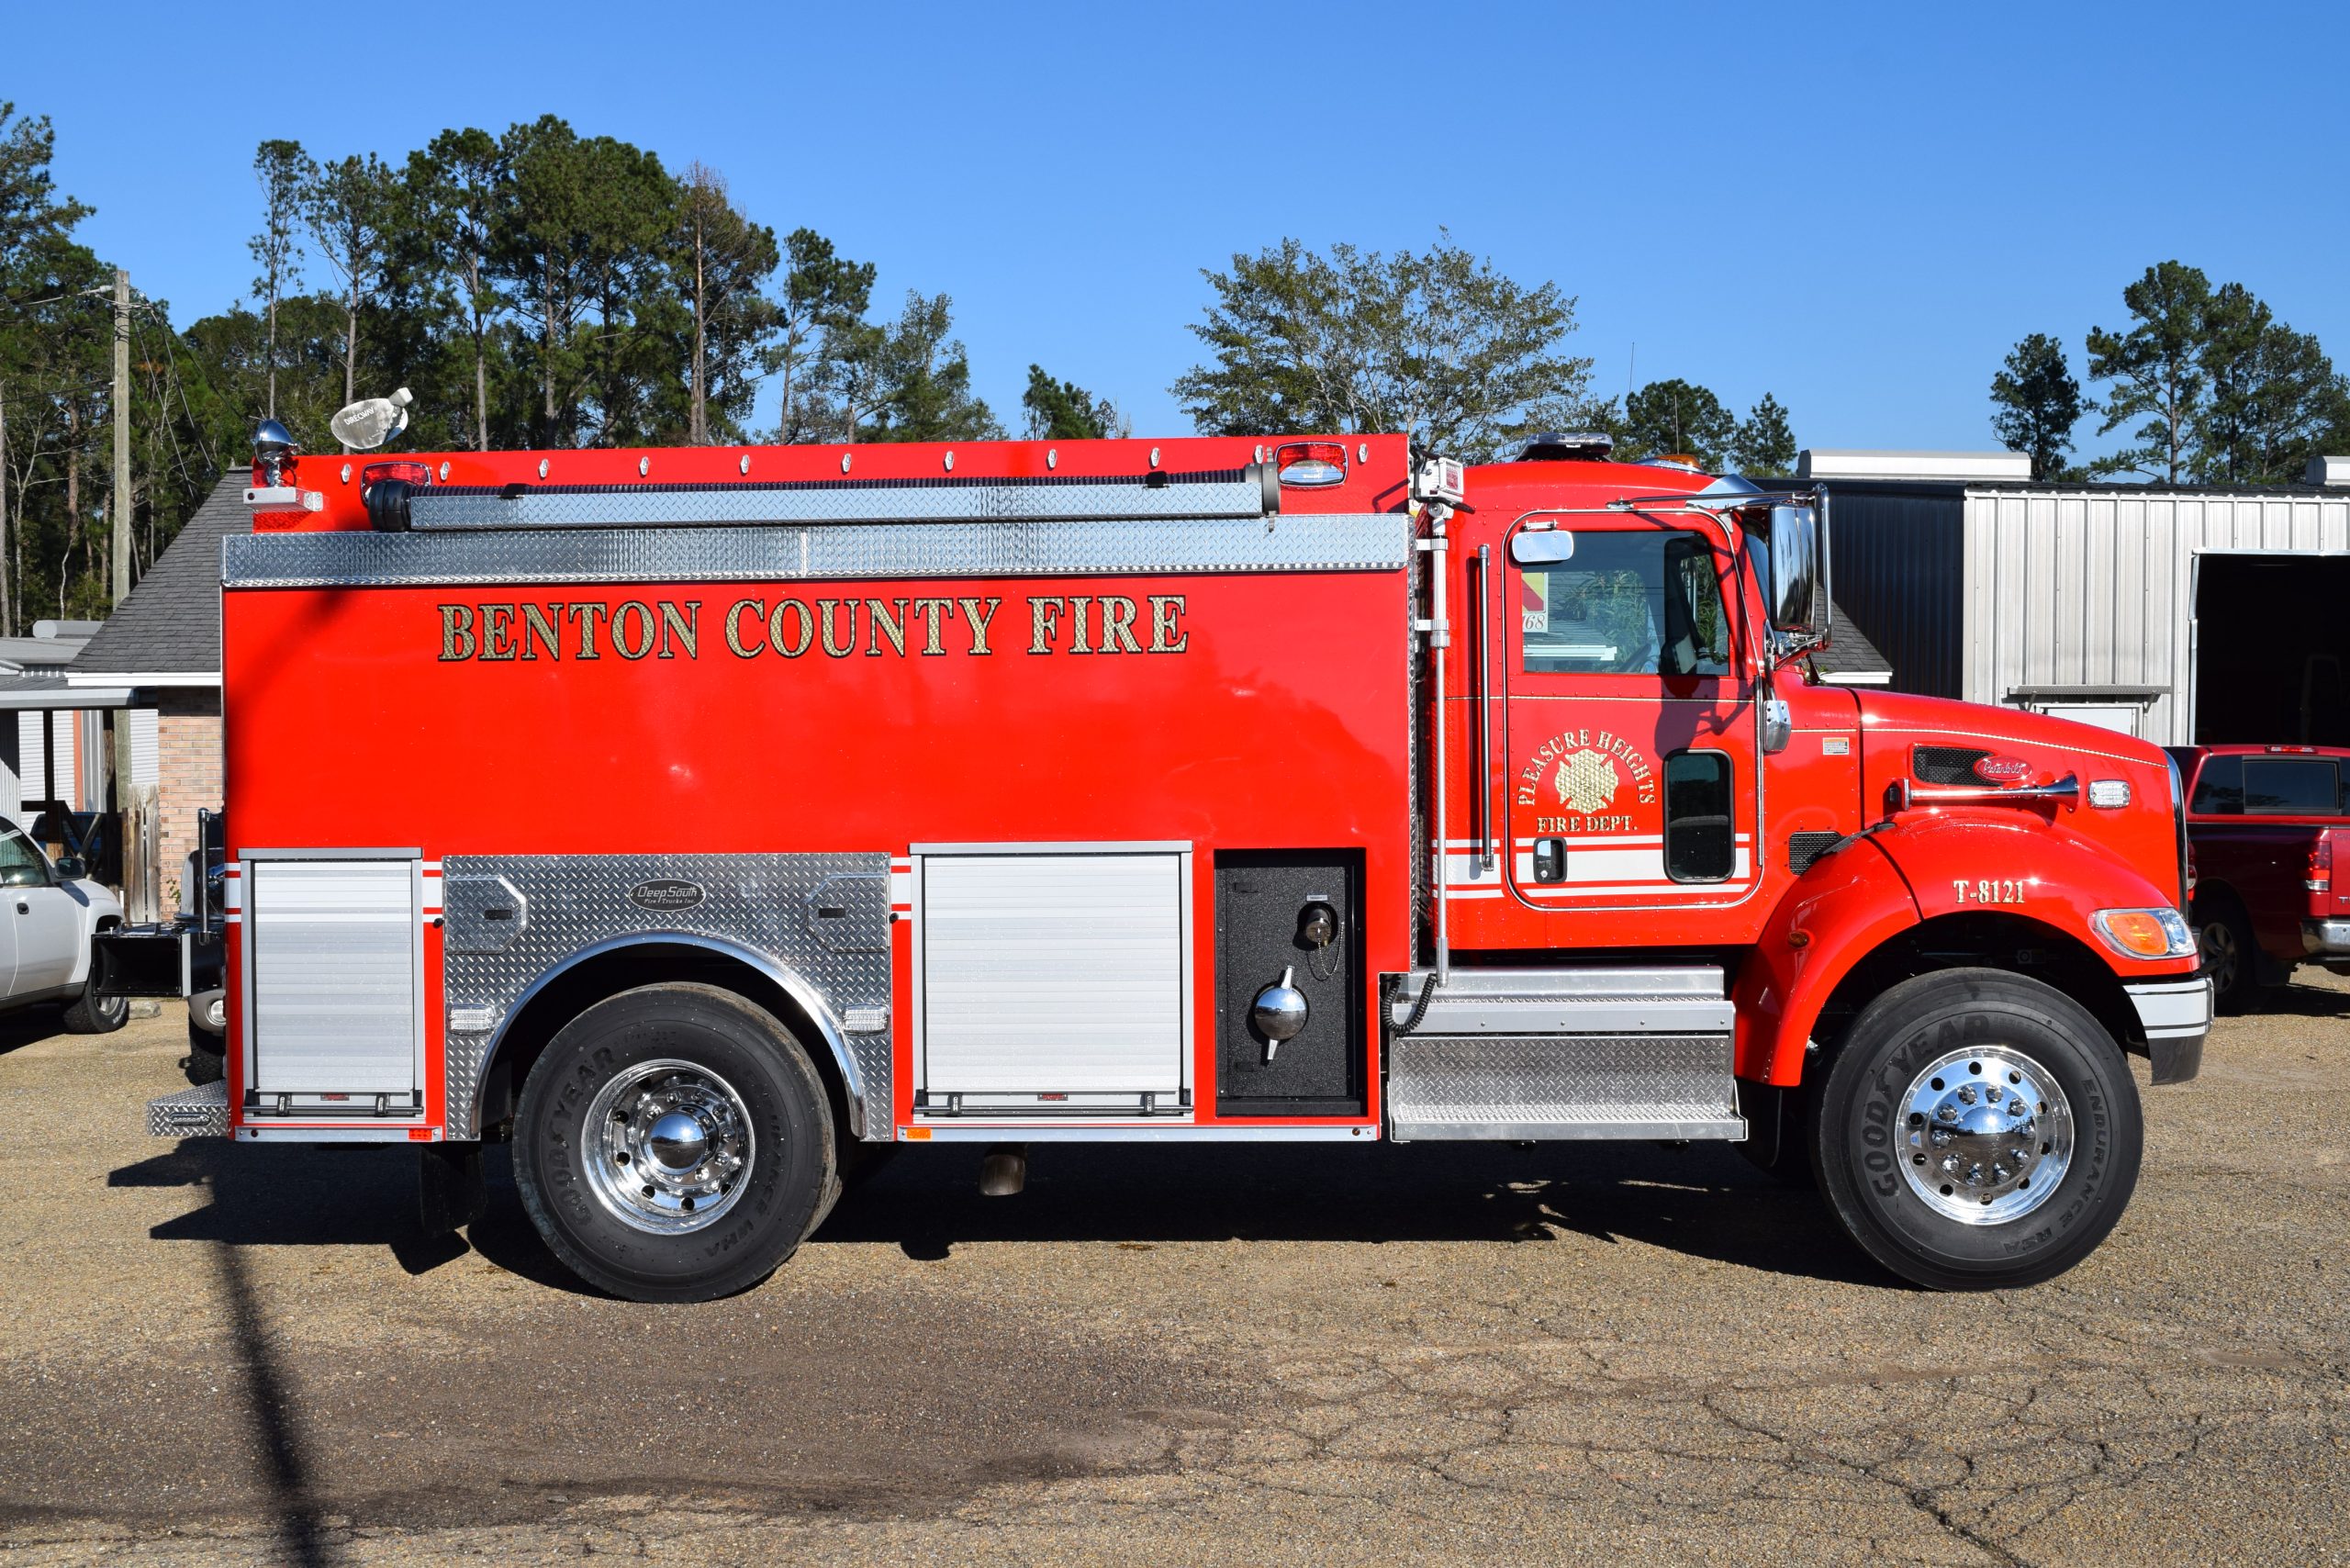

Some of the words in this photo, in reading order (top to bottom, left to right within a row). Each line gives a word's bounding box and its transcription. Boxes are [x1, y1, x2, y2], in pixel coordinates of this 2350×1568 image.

[343, 407, 375, 426] DIRECWAY
[438, 600, 701, 662] BENTON
[724, 597, 1002, 659] COUNTY
[1026, 595, 1189, 655] FIRE
[1523, 614, 1545, 630] 68
[1517, 729, 1590, 806] PLEASURE
[1596, 730, 1656, 804] HEIGHTS
[1537, 816, 1581, 833] FIRE
[1586, 815, 1639, 832] DEPT.
[1953, 879, 2025, 904] T-8121
[2059, 1079, 2112, 1228] ENDURANCE
